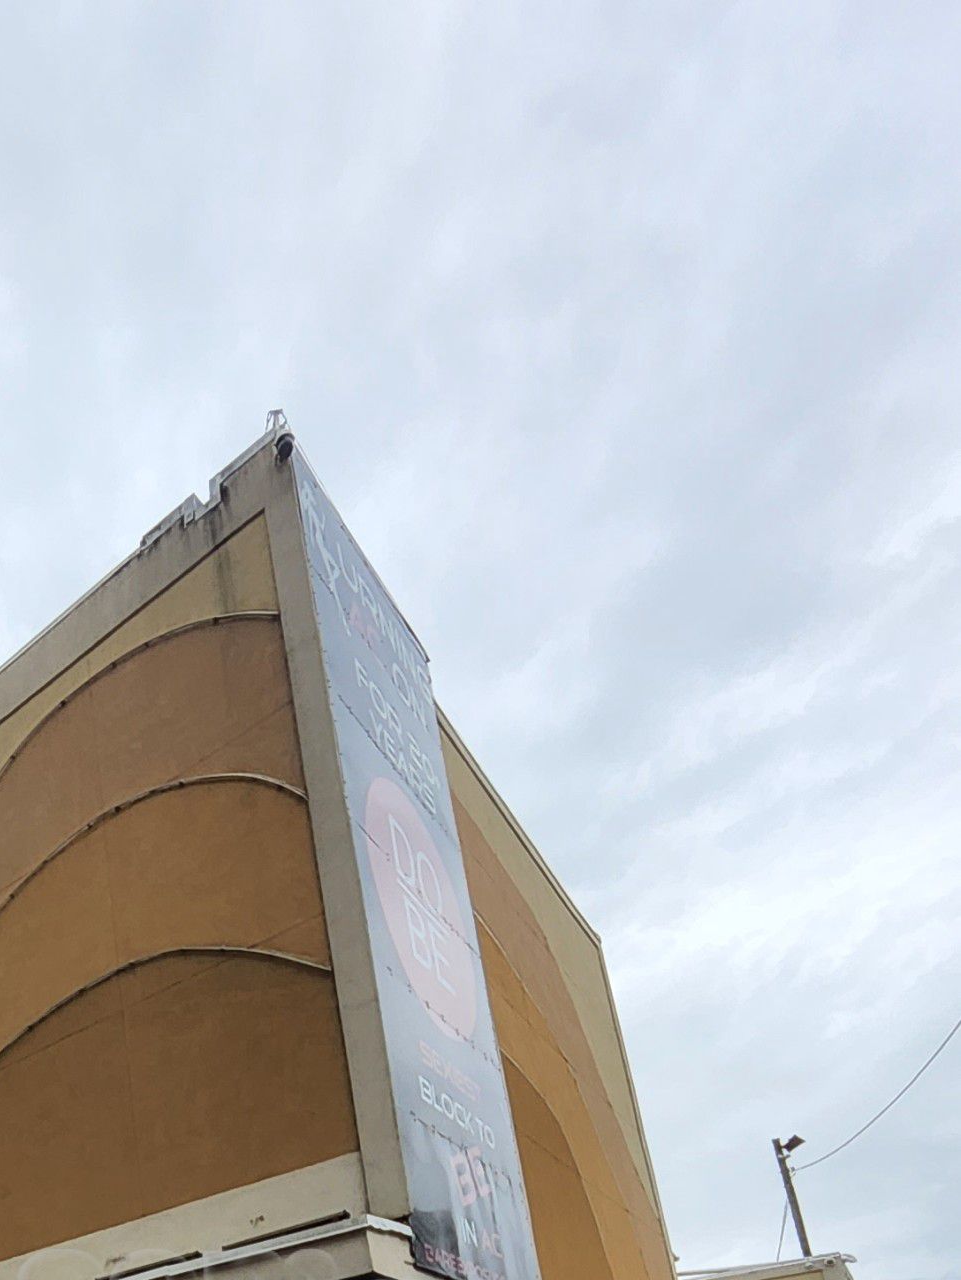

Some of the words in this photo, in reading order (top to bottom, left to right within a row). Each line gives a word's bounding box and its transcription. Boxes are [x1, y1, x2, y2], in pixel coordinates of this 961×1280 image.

[354, 657, 404, 746] FOR
[368, 708, 436, 816] YEARS
[388, 812, 443, 916] DO
[404, 894, 457, 996] BE
[418, 1075, 475, 1137] BLOCK
[475, 1117, 496, 1150] TO
[462, 1217, 479, 1248] IN
